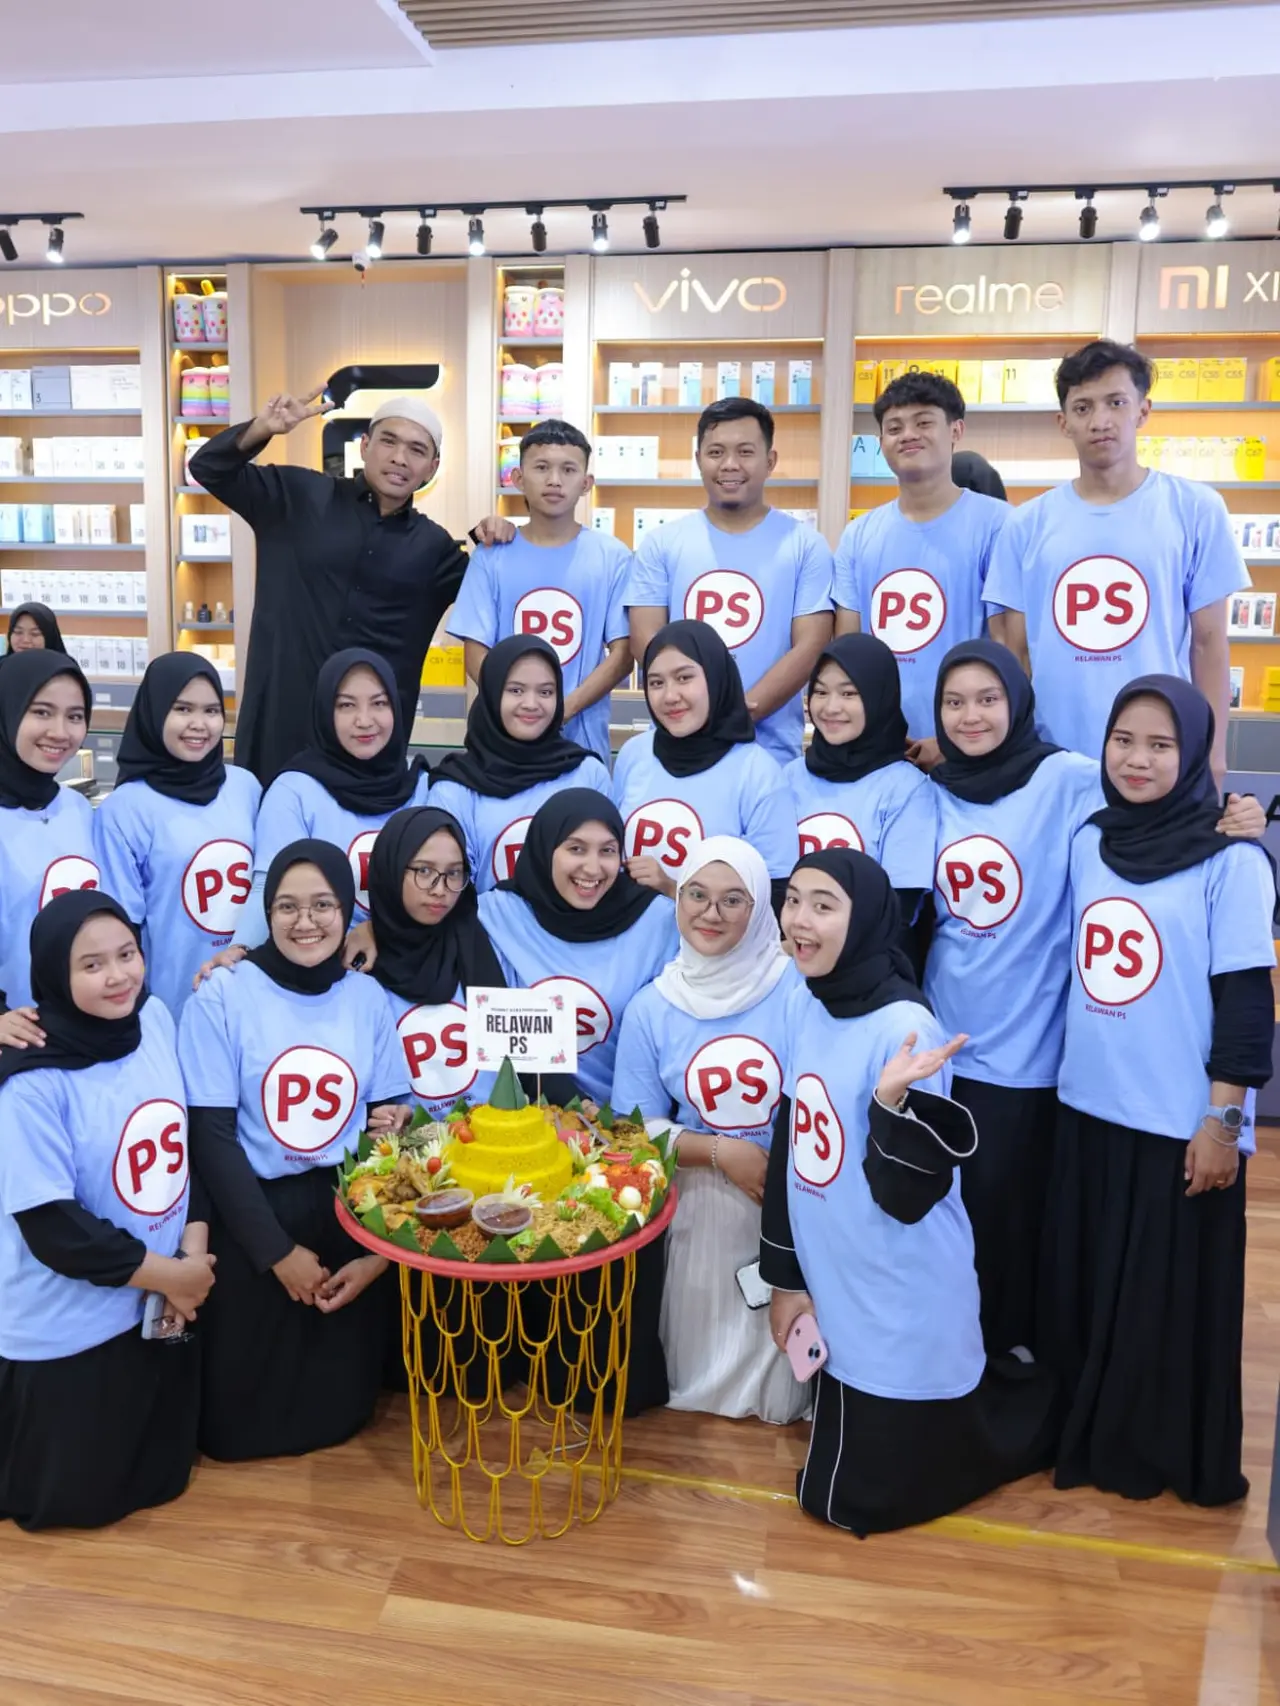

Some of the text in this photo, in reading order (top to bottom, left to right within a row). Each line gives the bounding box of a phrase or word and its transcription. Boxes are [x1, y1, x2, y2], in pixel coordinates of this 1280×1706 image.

[0, 292, 112, 326] ppo
[633, 267, 787, 314] vivo
[894, 274, 1066, 316] realme
[1005, 368, 1017, 380] 11
[695, 590, 751, 628] PS
[878, 591, 933, 631] PS
[1066, 581, 1134, 626] PS
[521, 609, 574, 646] PS
[1074, 655, 1112, 663] RELAWAN
[632, 817, 692, 868] PS
[195, 861, 252, 914] PS
[945, 860, 1006, 904] PS
[1084, 922, 1145, 979] PS
[486, 1014, 553, 1034] RELAWAN
[1085, 1003, 1127, 1020] RELAWAN PS
[402, 1022, 467, 1080] PS
[509, 1035, 528, 1055] PS
[277, 1073, 344, 1123] PS
[697, 1058, 768, 1113] PS
[794, 1097, 831, 1161] PS
[127, 1121, 184, 1195] PS
